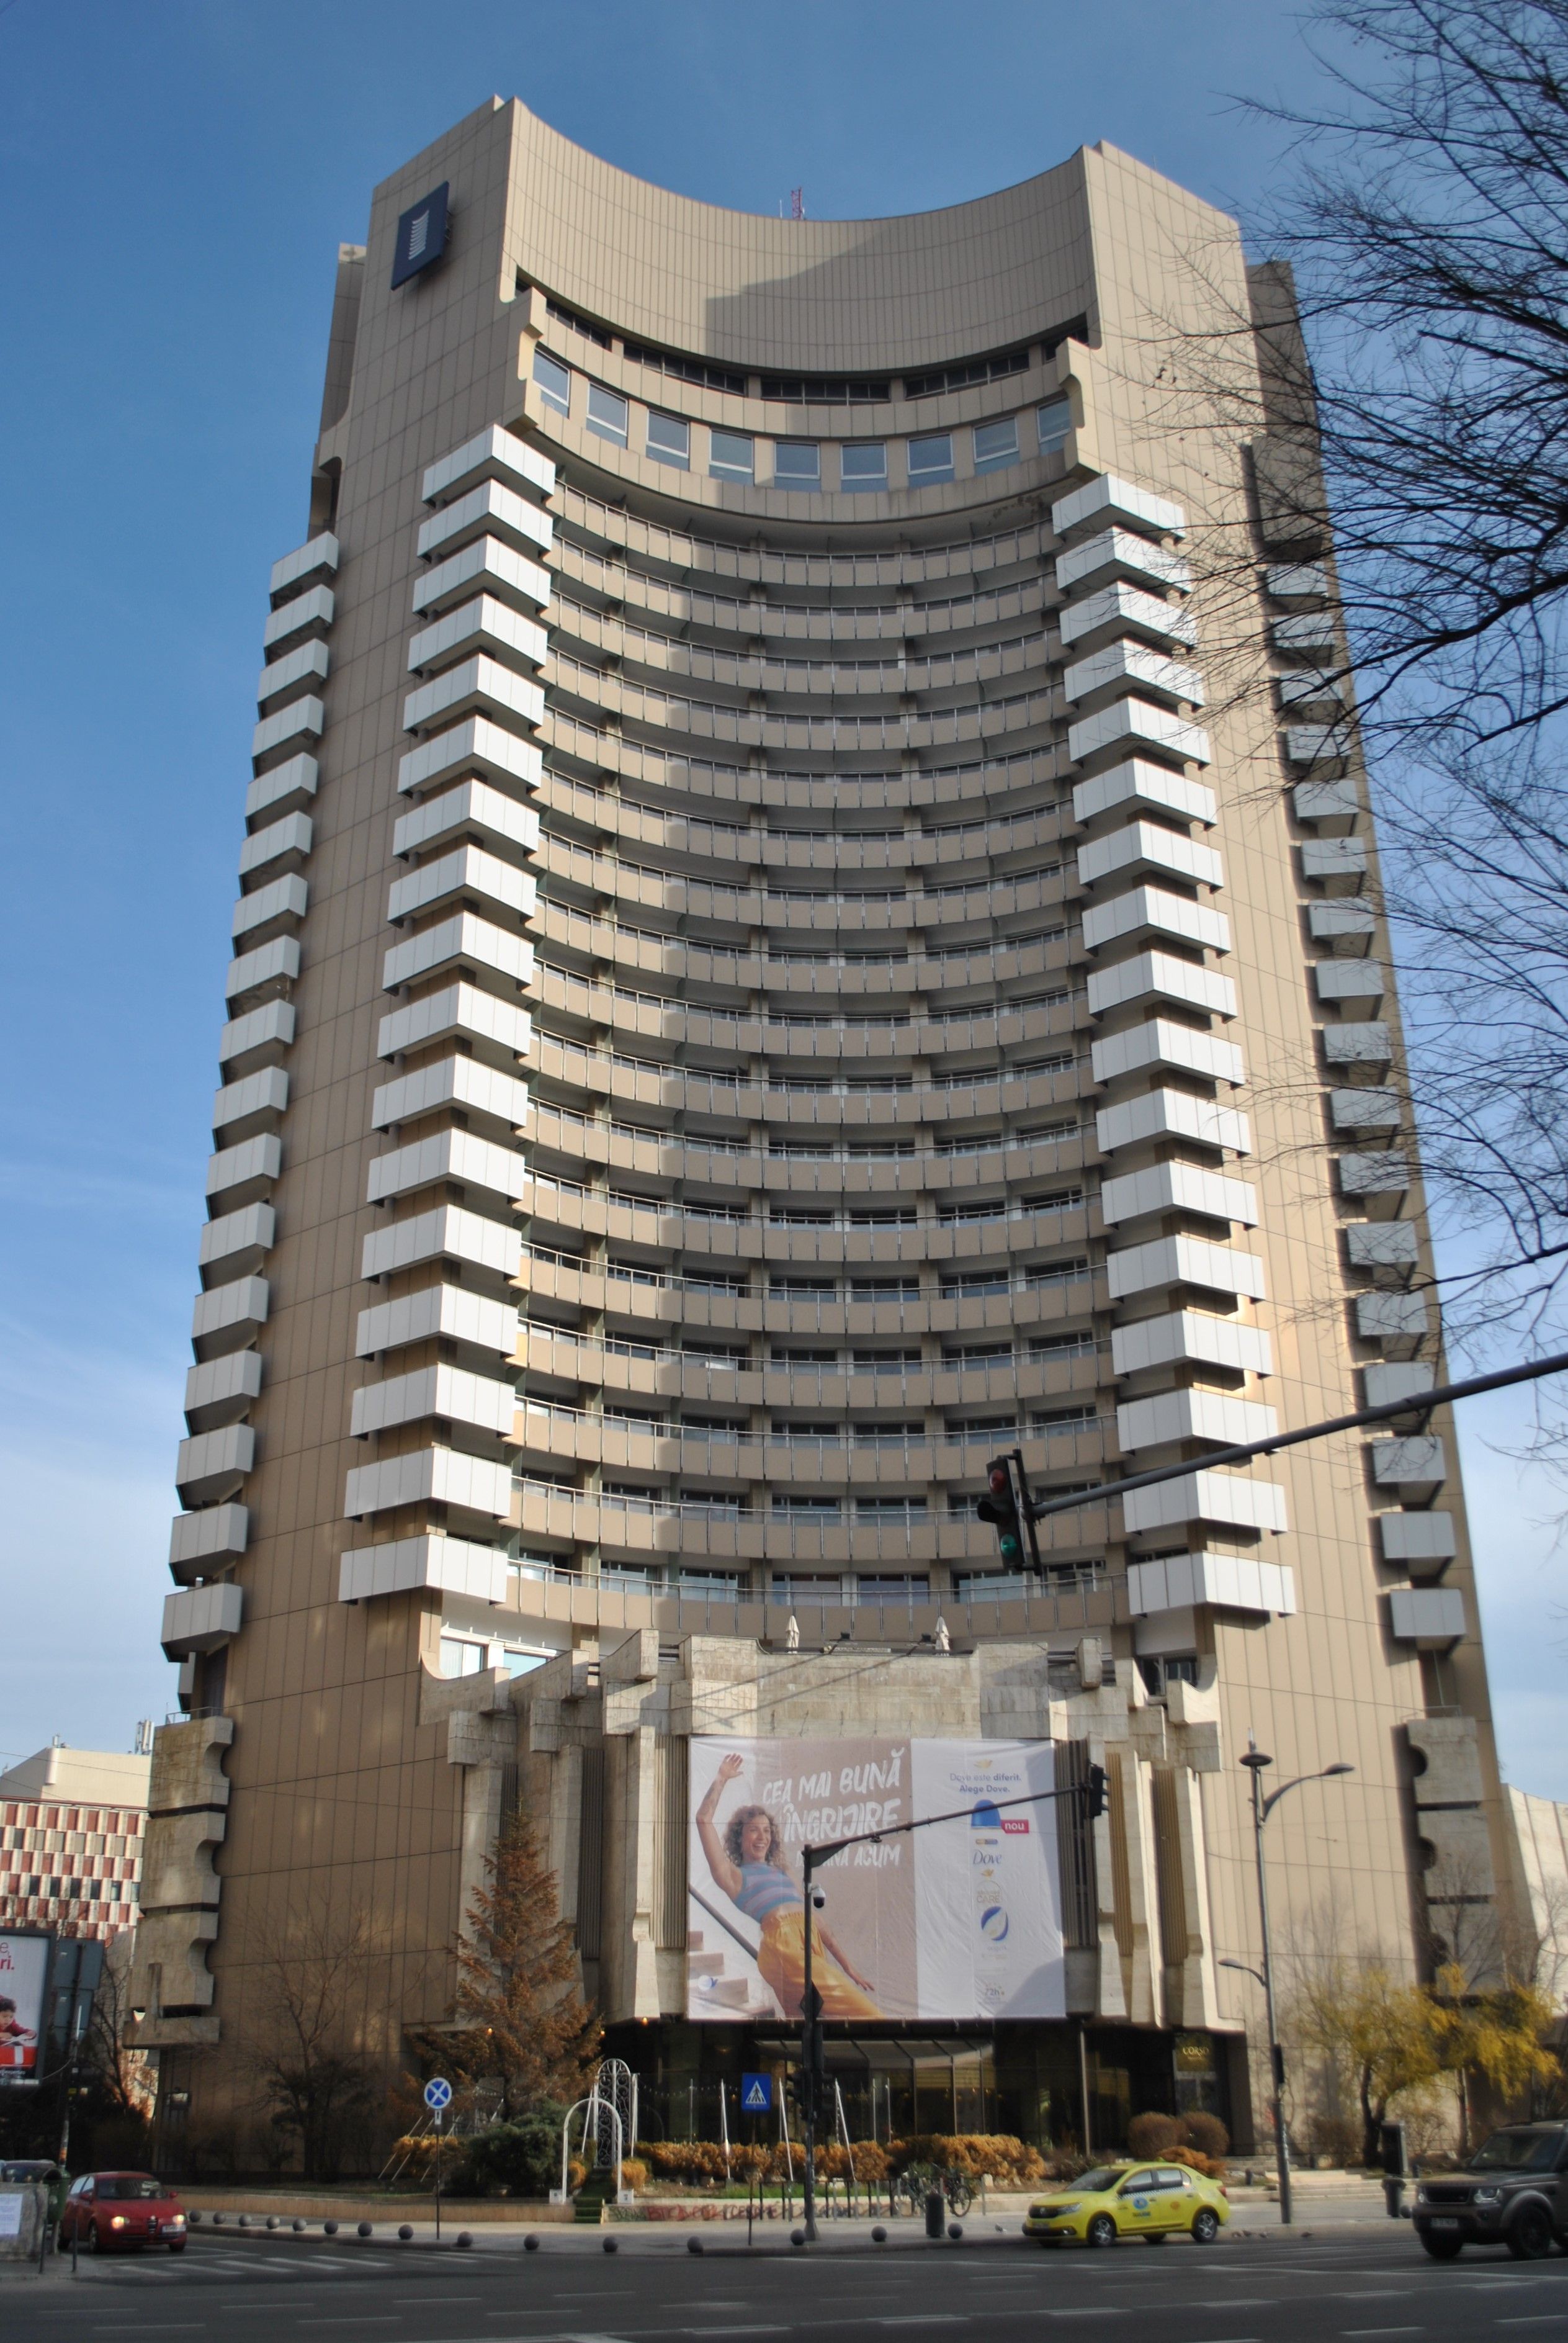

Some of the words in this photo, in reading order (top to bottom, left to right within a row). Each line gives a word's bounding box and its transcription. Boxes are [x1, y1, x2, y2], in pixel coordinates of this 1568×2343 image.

[763, 1778, 792, 1804] CEA
[799, 1771, 831, 1801] MAI
[839, 1747, 905, 1795] BUNĂ
[950, 1773, 971, 1781] Dove
[993, 1773, 1021, 1781] diferit.
[959, 1785, 983, 1794] Alege
[783, 1798, 901, 1842] ÎNGRIJIRE
[854, 1844, 901, 1868] ACUM
[973, 1849, 1001, 1864] Dove
